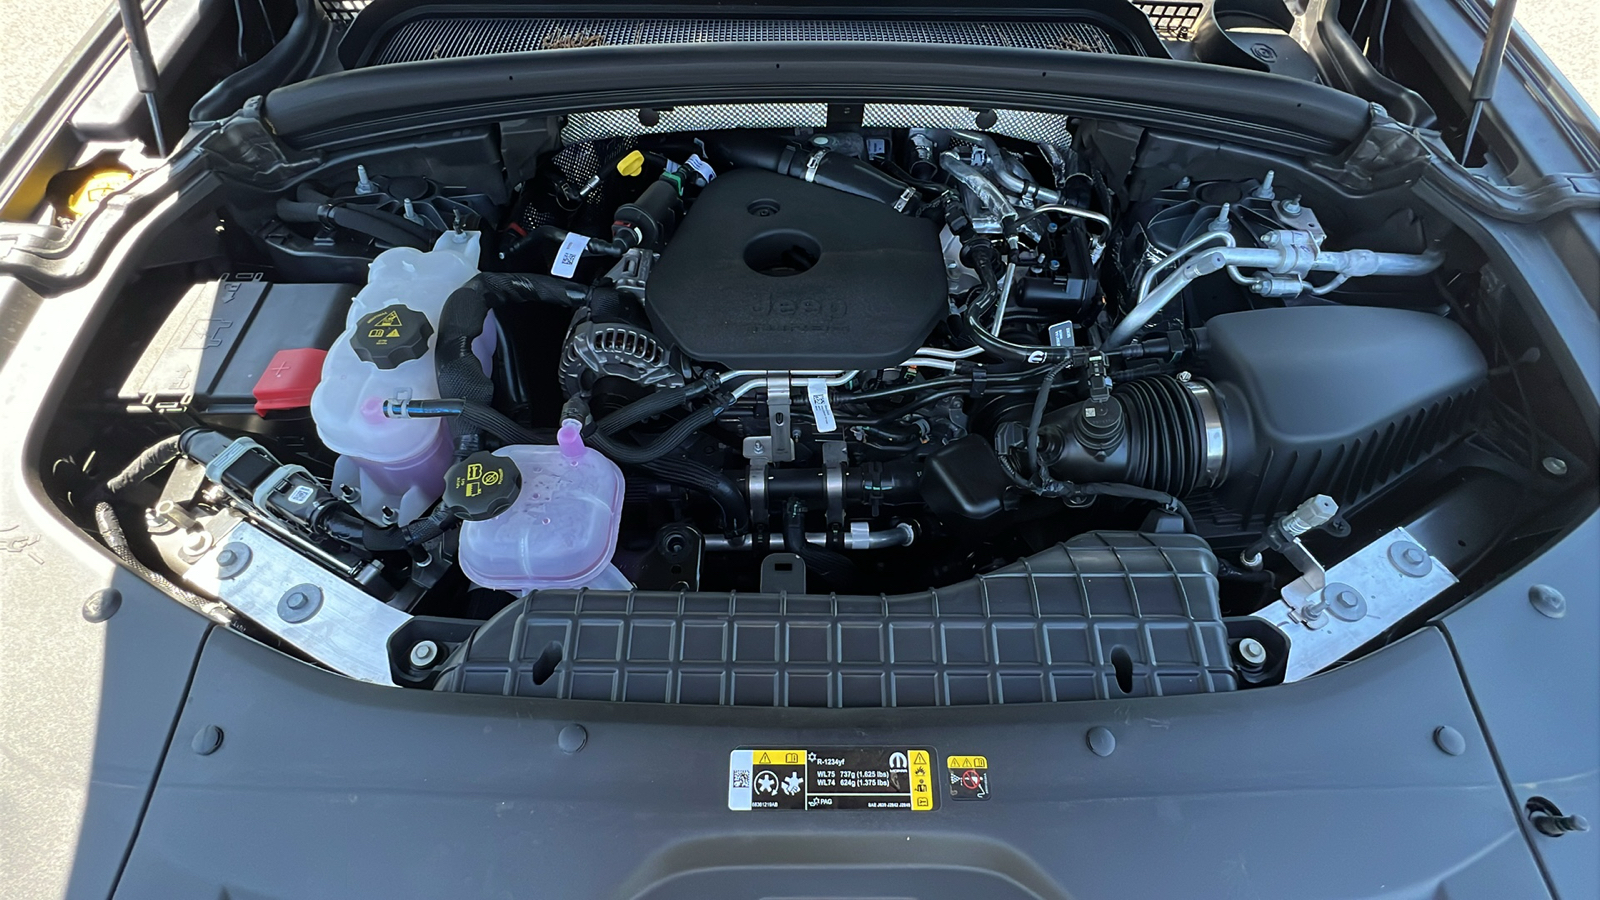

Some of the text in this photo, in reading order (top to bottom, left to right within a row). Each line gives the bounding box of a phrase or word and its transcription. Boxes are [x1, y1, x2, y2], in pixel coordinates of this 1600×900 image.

[751, 293, 848, 320] Jeep
[840, 771, 855, 779] 737g
[857, 771, 876, 779] (1.625
[877, 771, 889, 779] lbs)
[840, 779, 856, 787] 624g
[857, 779, 876, 787] (1.375
[877, 779, 890, 787] lbs)
